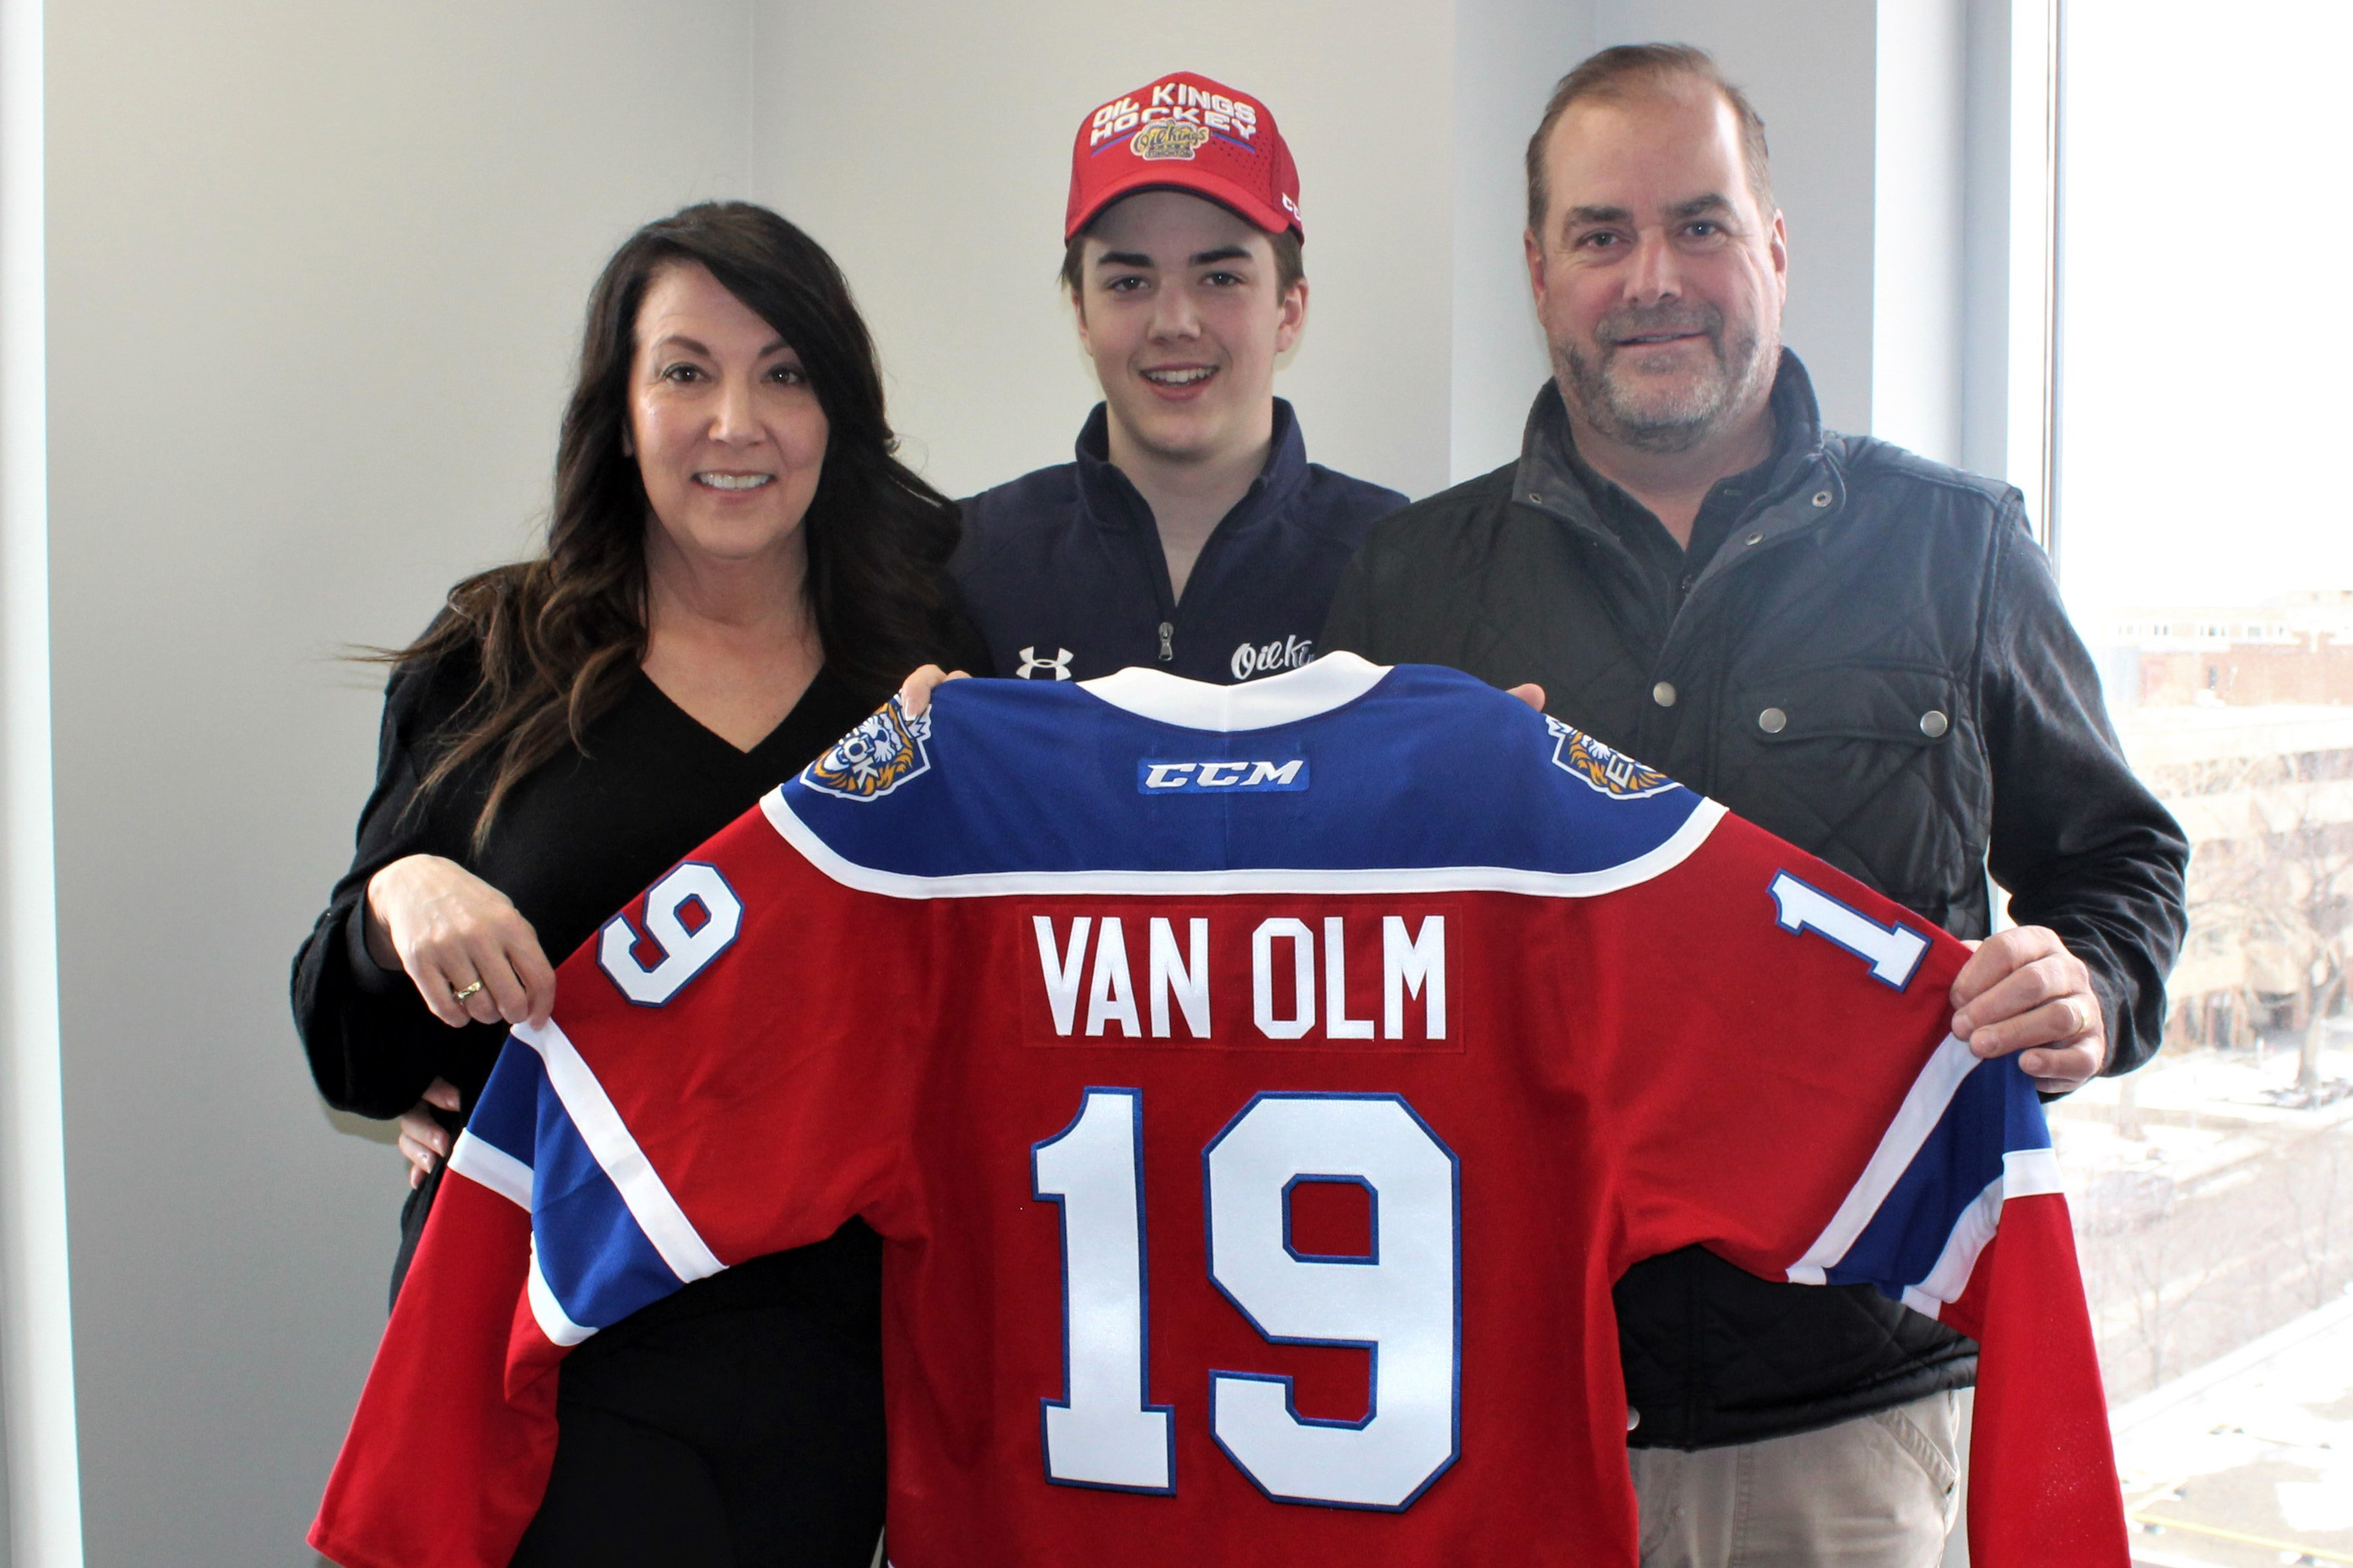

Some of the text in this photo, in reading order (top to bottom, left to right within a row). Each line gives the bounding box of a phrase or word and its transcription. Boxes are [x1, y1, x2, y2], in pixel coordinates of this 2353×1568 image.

[1089, 106, 1257, 147] HOCKEY
[1092, 82, 1257, 129] OIL KINGS
[1145, 759, 1304, 789] CCM
[596, 860, 746, 1009] 9
[1032, 914, 1447, 1040] VAN OLM
[1766, 867, 1934, 994] 1
[1030, 1085, 1461, 1514] 19
